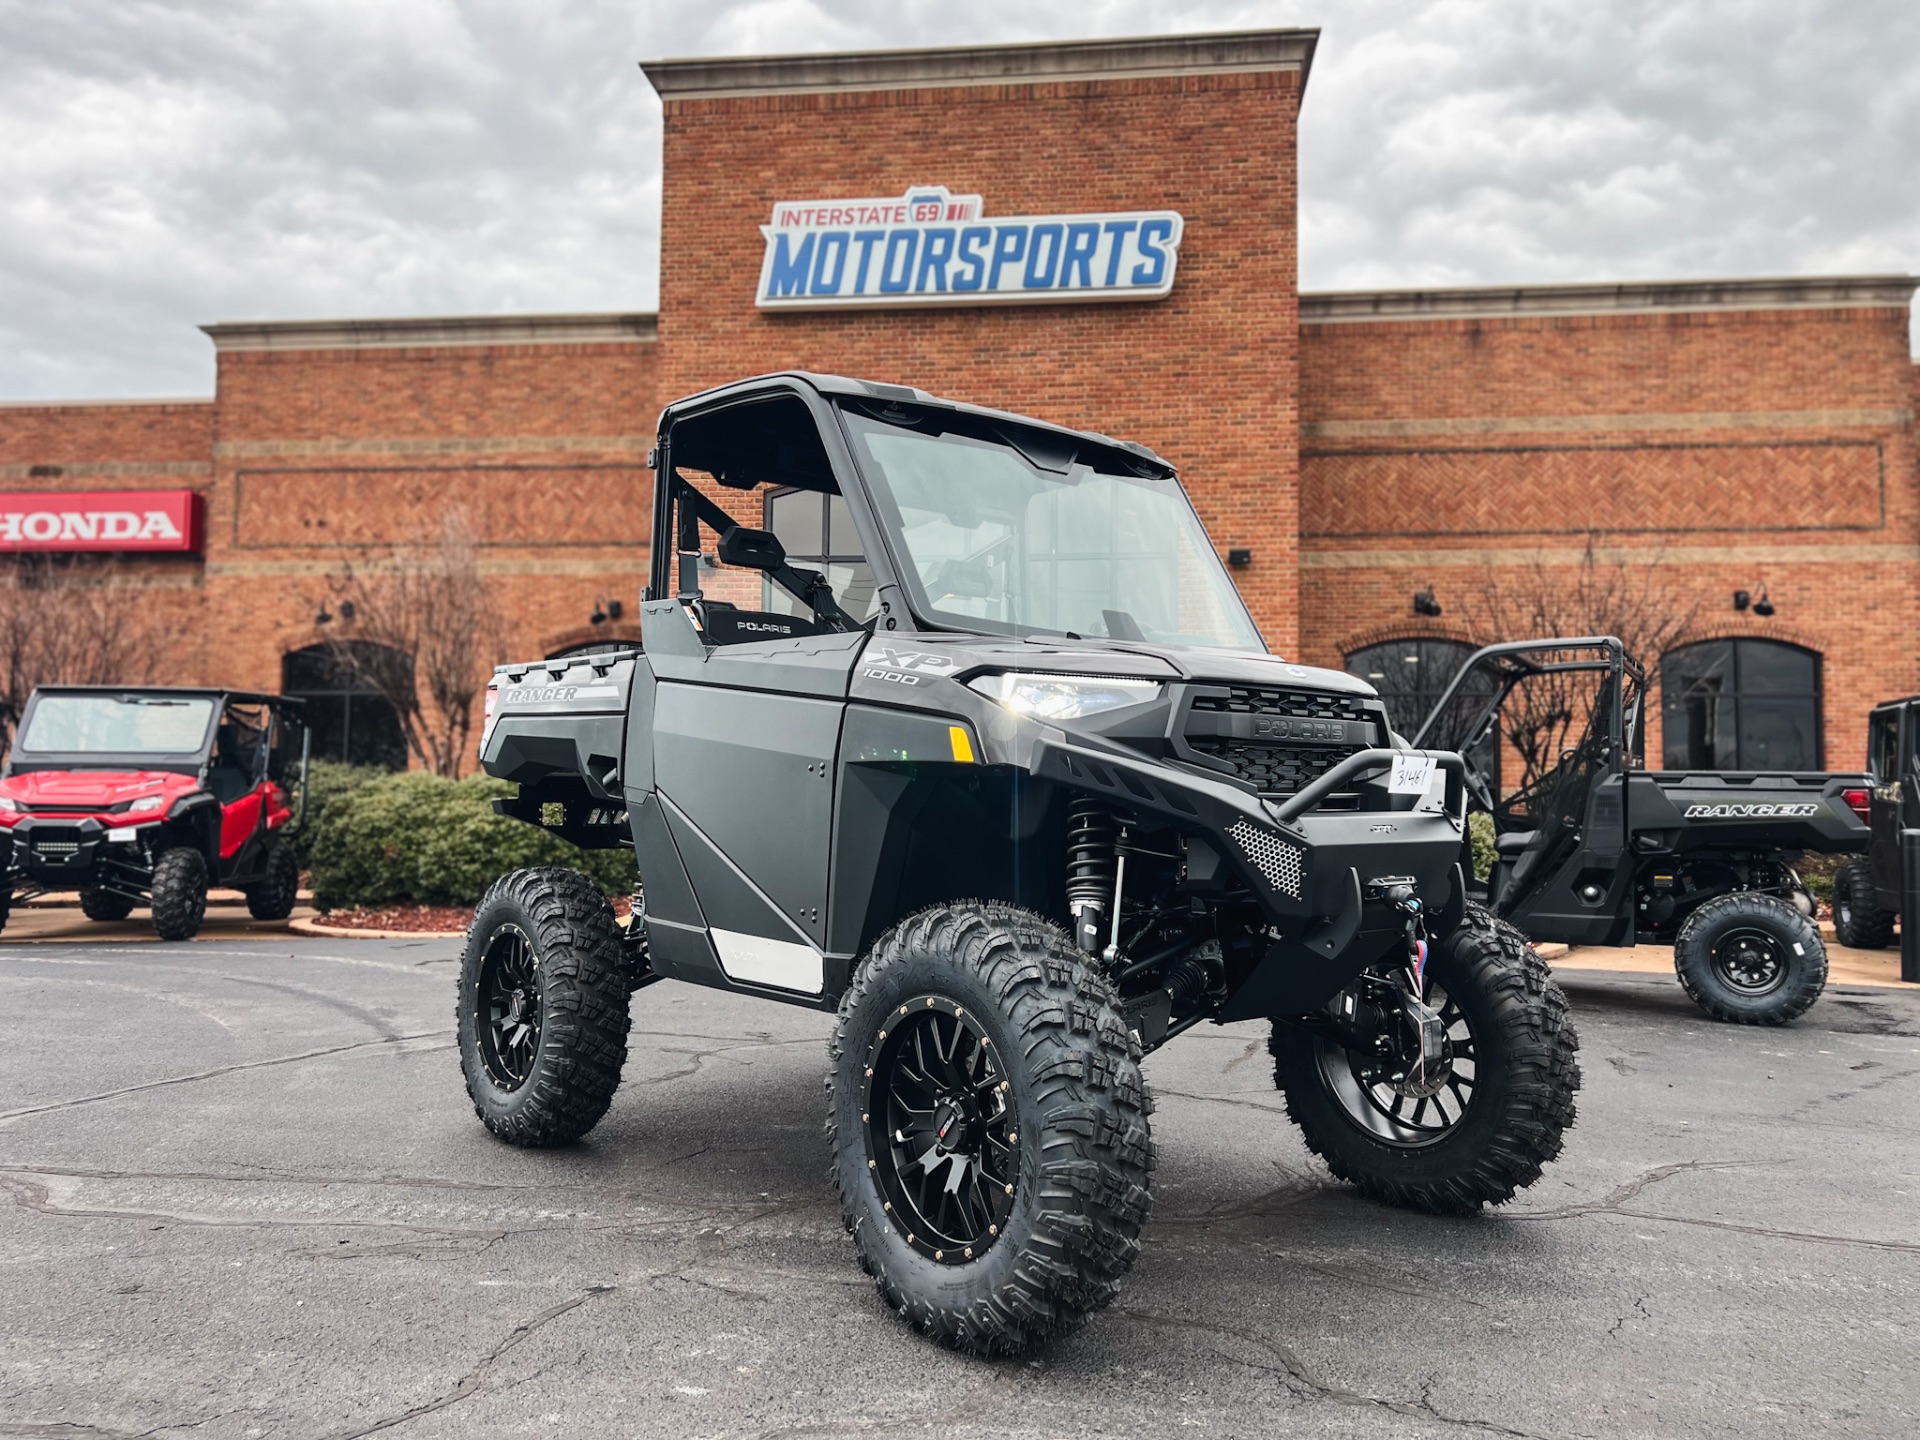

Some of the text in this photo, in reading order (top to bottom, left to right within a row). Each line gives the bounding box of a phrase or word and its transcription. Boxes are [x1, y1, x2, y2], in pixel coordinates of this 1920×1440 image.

[780, 203, 940, 227] INTERSTATE 69
[767, 219, 1173, 297] MOTORSPORTS
[736, 621, 792, 634] POLARIS
[866, 647, 954, 670] XP
[863, 668, 920, 686] 1000
[507, 686, 578, 703] RANGER
[1254, 718, 1345, 742] POLARIS
[1684, 804, 1818, 817] RANGER
